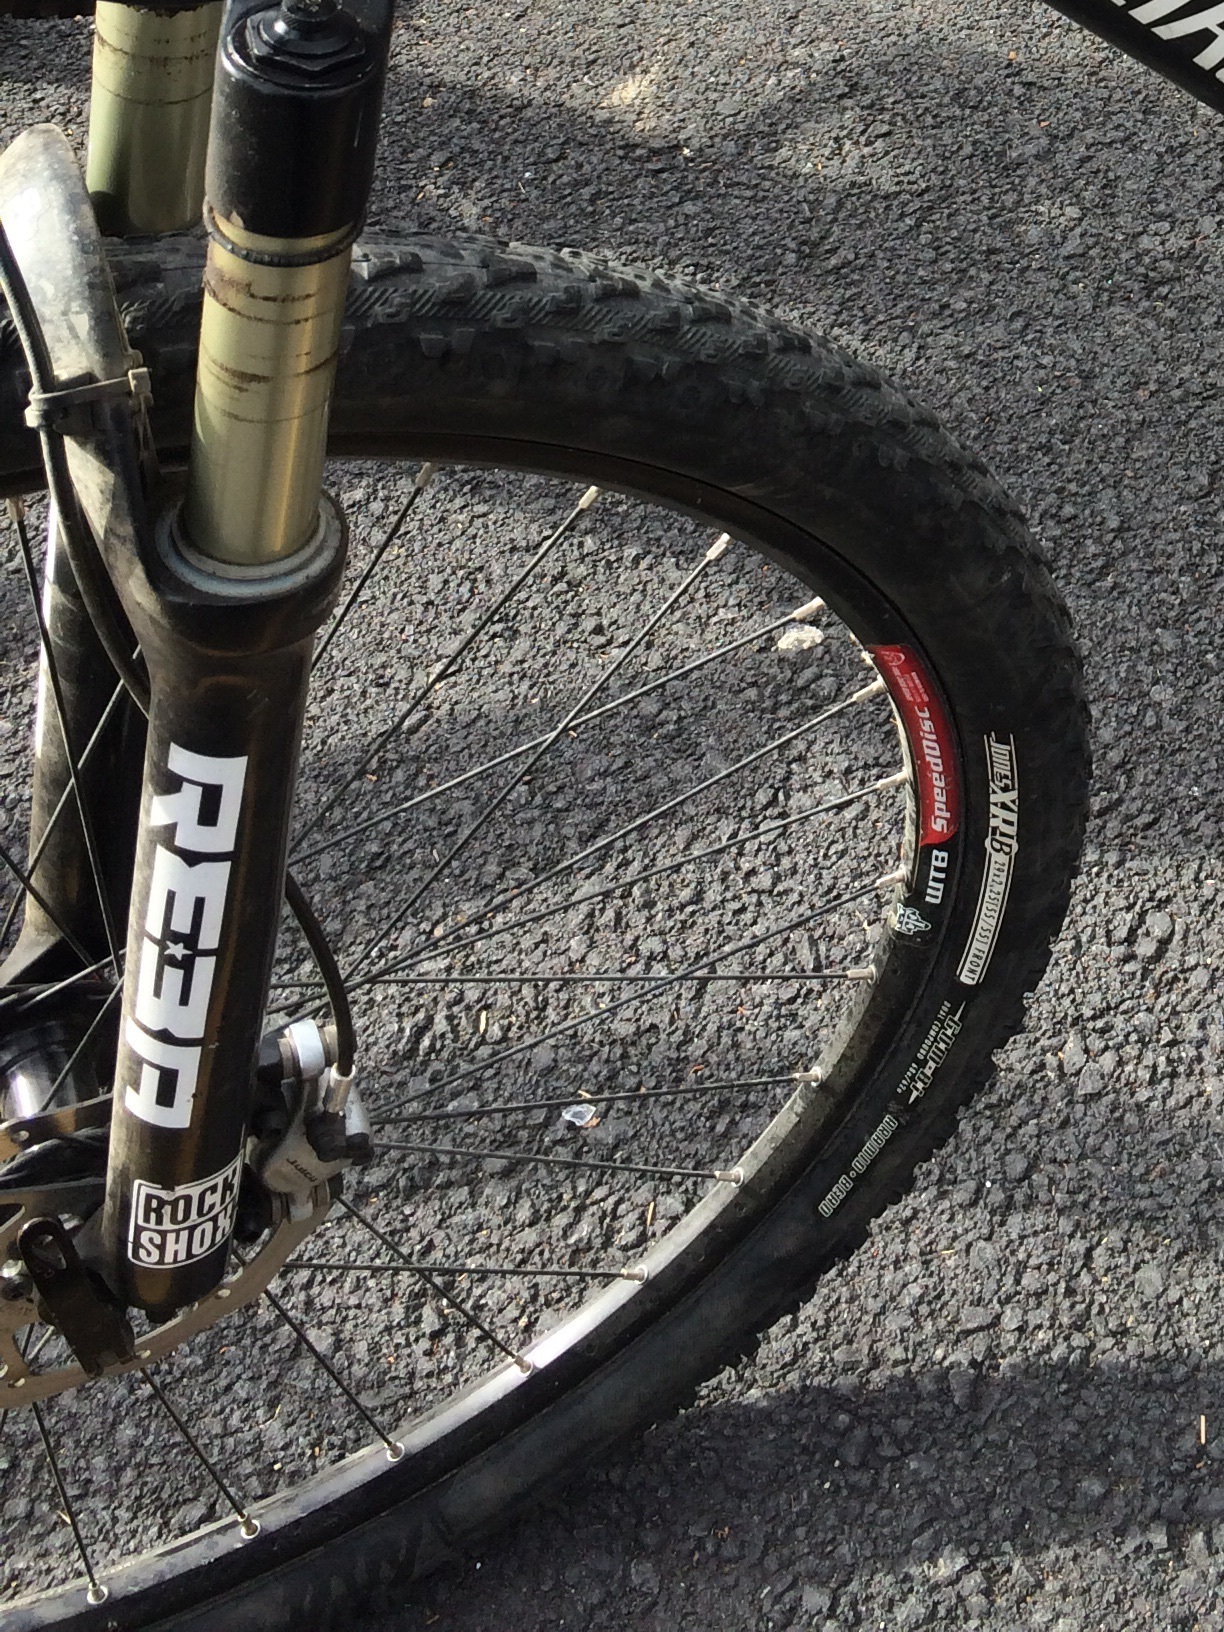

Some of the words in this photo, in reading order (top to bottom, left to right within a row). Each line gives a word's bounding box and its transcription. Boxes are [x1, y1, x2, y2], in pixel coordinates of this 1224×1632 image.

[925, 848, 948, 905] WTB
[125, 741, 248, 1129] REBA
[963, 949, 987, 984] FRONT
[143, 1168, 240, 1227] ROCK
[138, 1205, 233, 1266] SHOX
